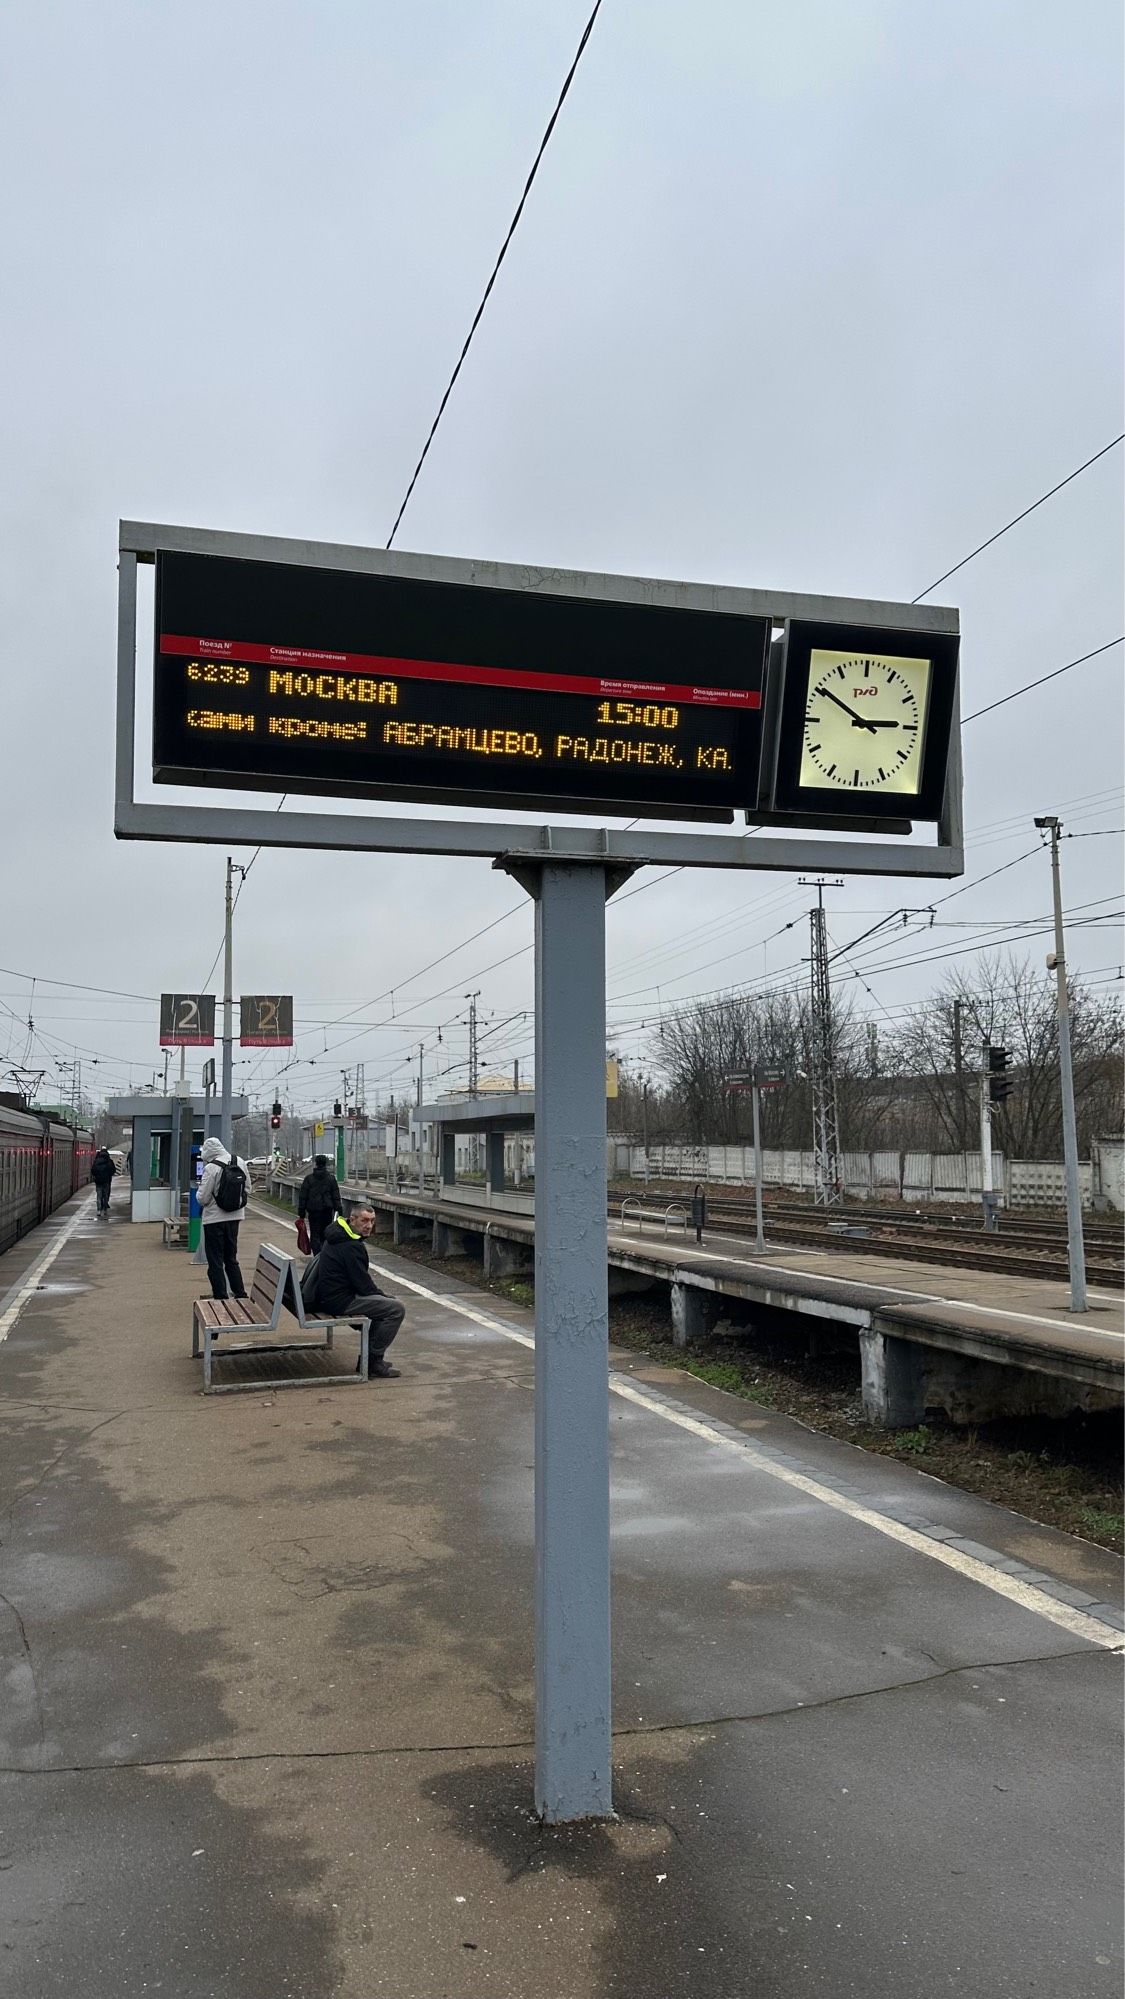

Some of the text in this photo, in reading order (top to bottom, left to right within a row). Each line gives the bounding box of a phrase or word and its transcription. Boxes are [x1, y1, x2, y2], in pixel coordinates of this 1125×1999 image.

[199, 639, 223, 649] Поезд
[269, 647, 347, 661] Станция назначения
[269, 654, 298, 662] Destination
[188, 663, 397, 704] 6239 МОСКВА
[600, 680, 666, 692] Время отправления
[693, 688, 749, 699] Опоздание (мин.)
[598, 702, 678, 728] 15:00
[269, 717, 366, 739] кроме:
[384, 722, 542, 758] АБРАМЦЕВО,
[557, 736, 682, 768] РАДОНЕЖ,
[179, 1000, 197, 1028] 2
[258, 1001, 276, 1029] 2
[352, 1108, 358, 1117] 3
